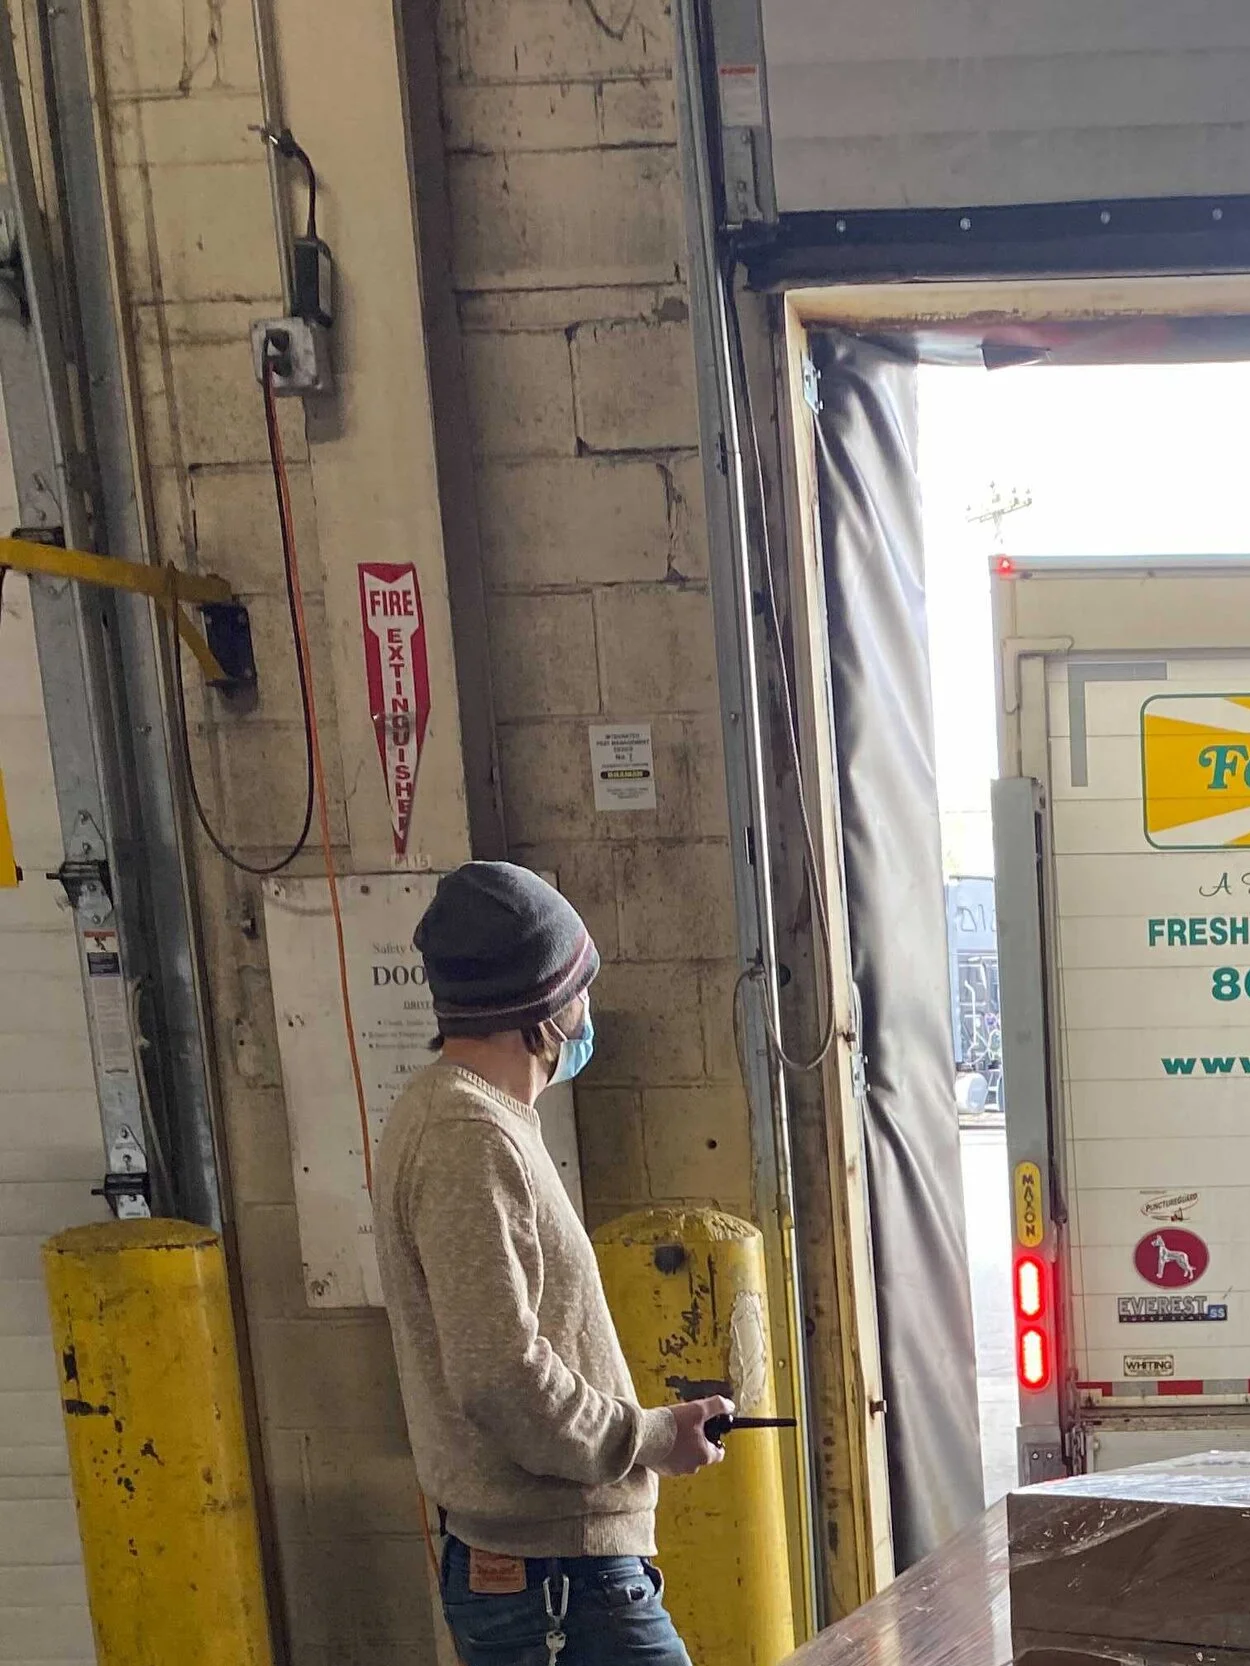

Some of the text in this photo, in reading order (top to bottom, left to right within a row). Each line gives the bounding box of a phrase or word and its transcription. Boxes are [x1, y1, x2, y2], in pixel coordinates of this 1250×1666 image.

[369, 590, 414, 617] FIRE
[387, 628, 411, 831] EXTINGUISHER
[1199, 871, 1232, 897] A
[1149, 917, 1250, 947] FRESH
[372, 941, 406, 957] Safety
[1022, 1174, 1036, 1237] MAXON
[1117, 1296, 1207, 1315] EVEREST
[1125, 1360, 1172, 1370] WHITING
